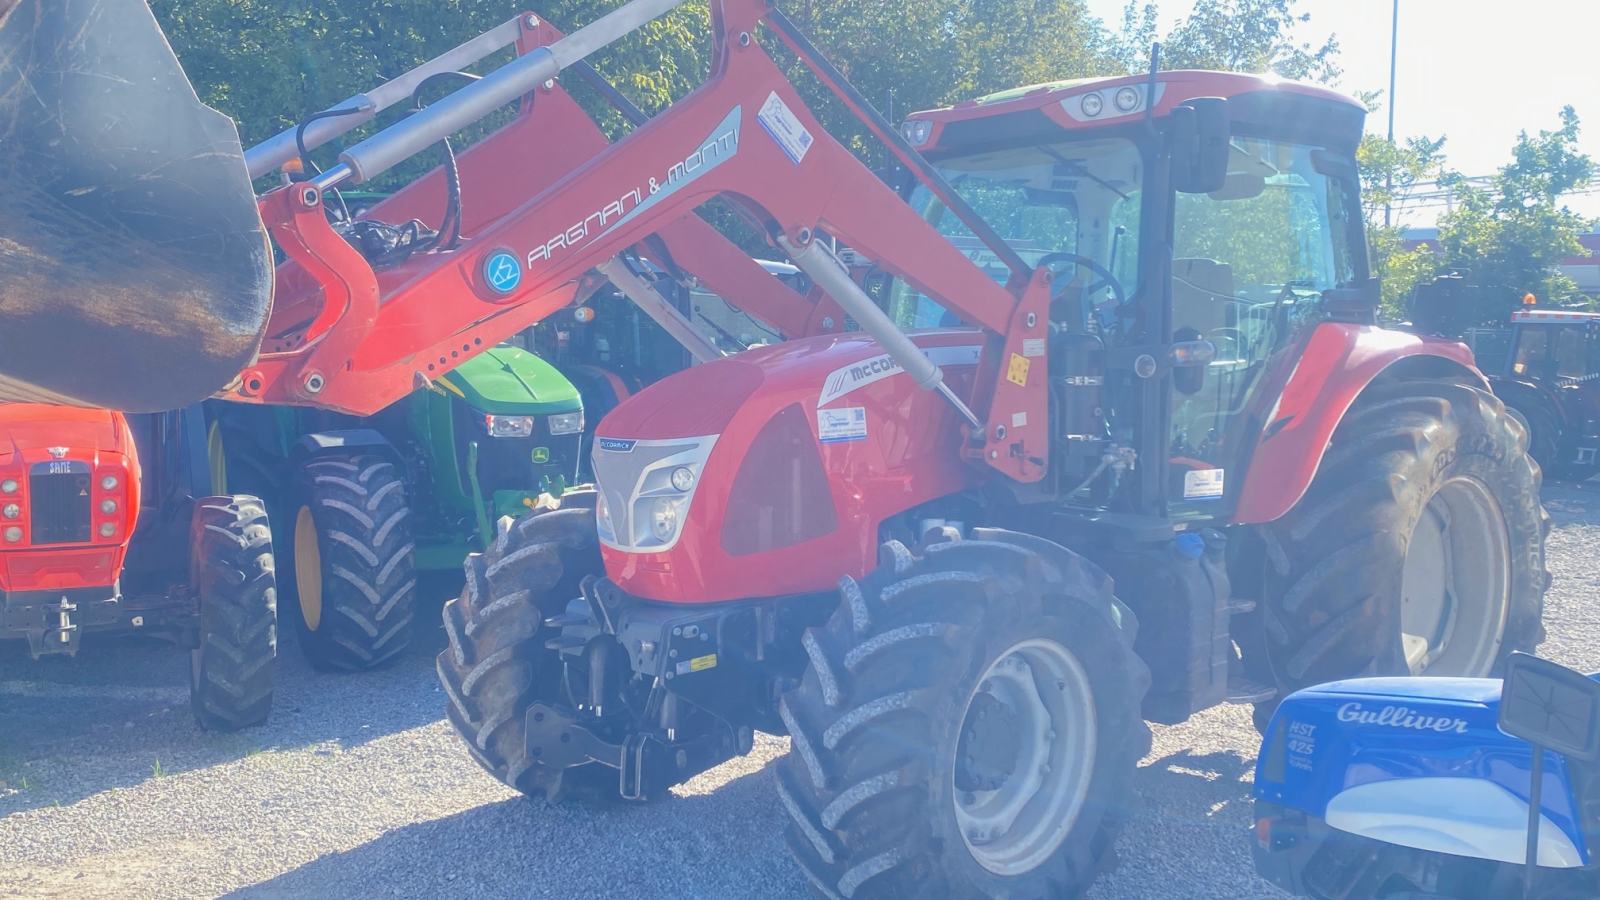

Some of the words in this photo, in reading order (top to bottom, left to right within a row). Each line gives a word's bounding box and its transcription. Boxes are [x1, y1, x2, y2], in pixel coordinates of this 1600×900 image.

[527, 187, 641, 270] ARGNANI
[648, 176, 661, 195] &
[49, 461, 71, 474] SAME
[1336, 701, 1468, 733] Gulliver
[1288, 740, 1315, 755] 425
